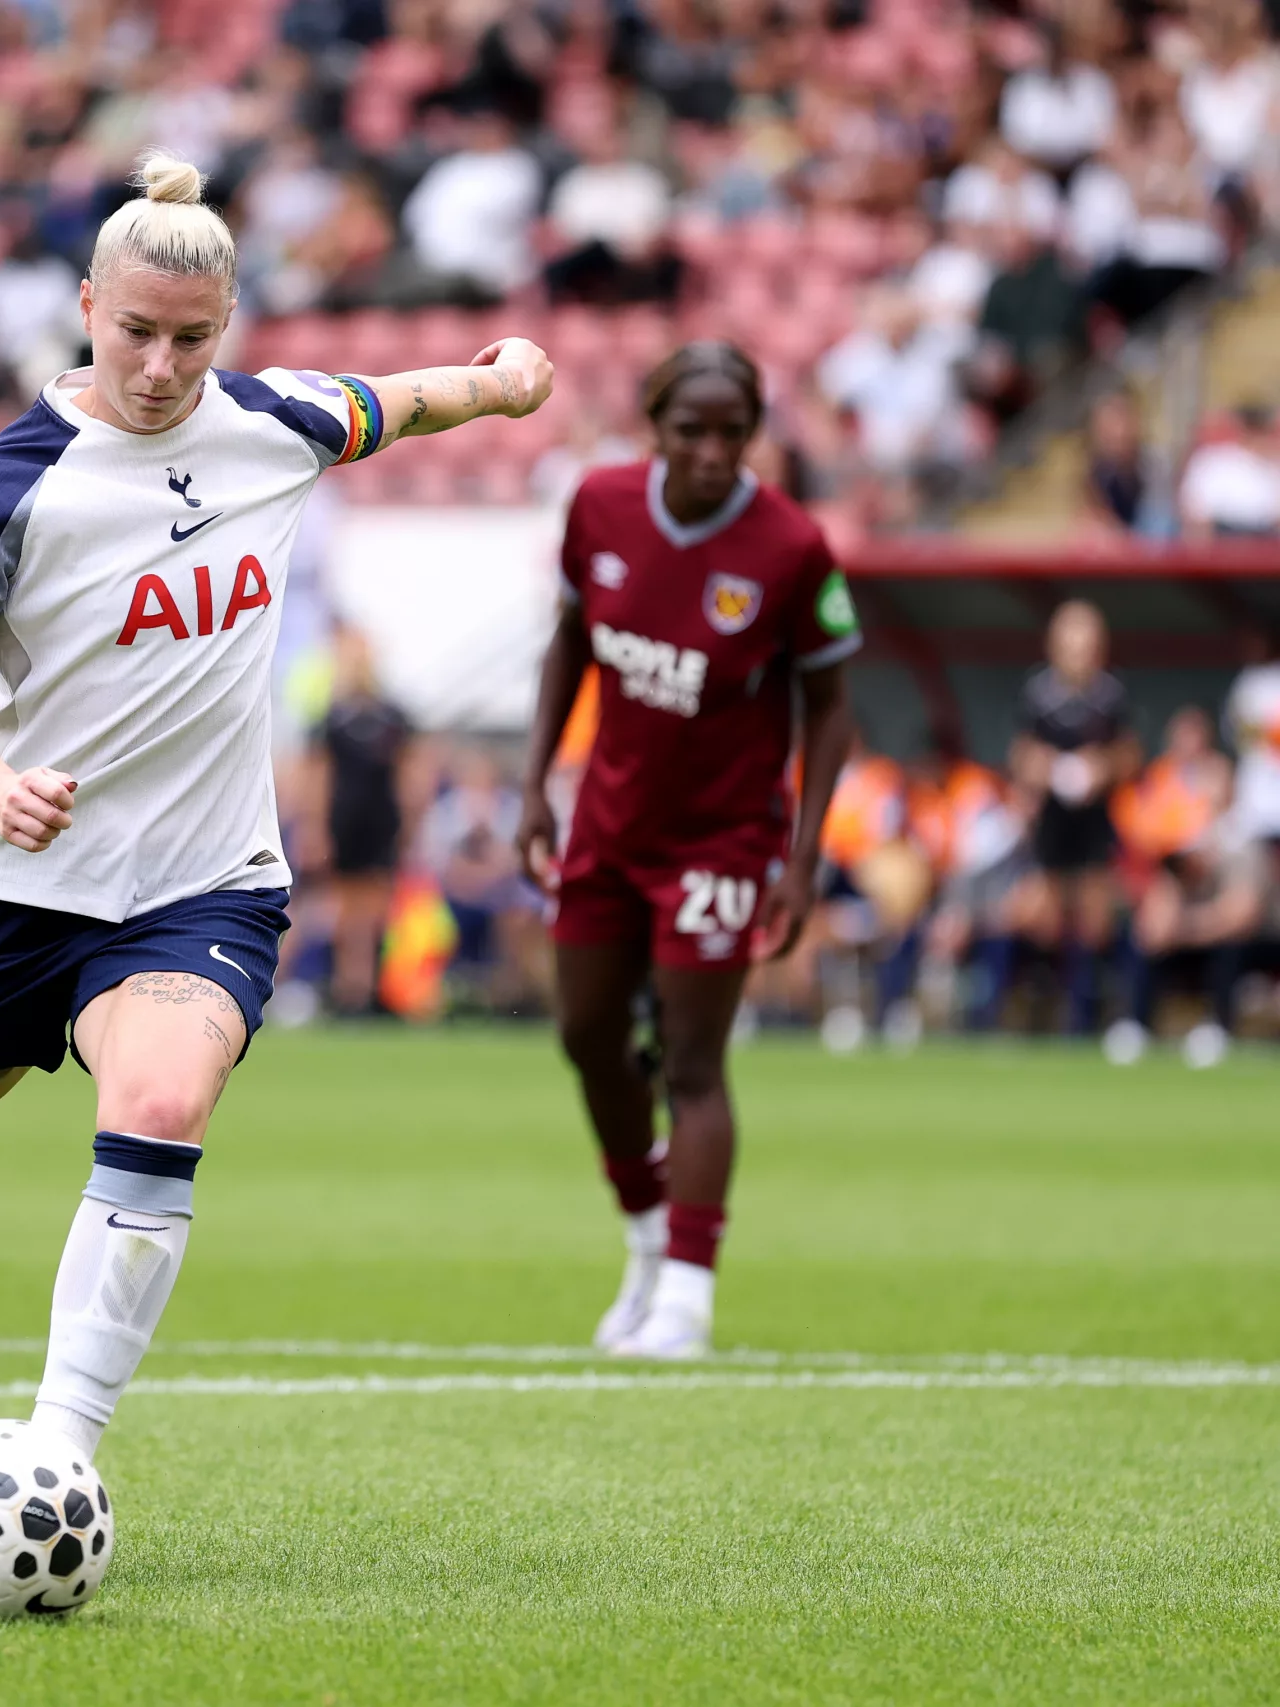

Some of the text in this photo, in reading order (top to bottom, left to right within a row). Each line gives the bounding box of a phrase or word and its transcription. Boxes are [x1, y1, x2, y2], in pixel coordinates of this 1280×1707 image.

[115, 554, 272, 646] AIA
[675, 868, 758, 934] 20
[200, 983, 222, 1000] the
